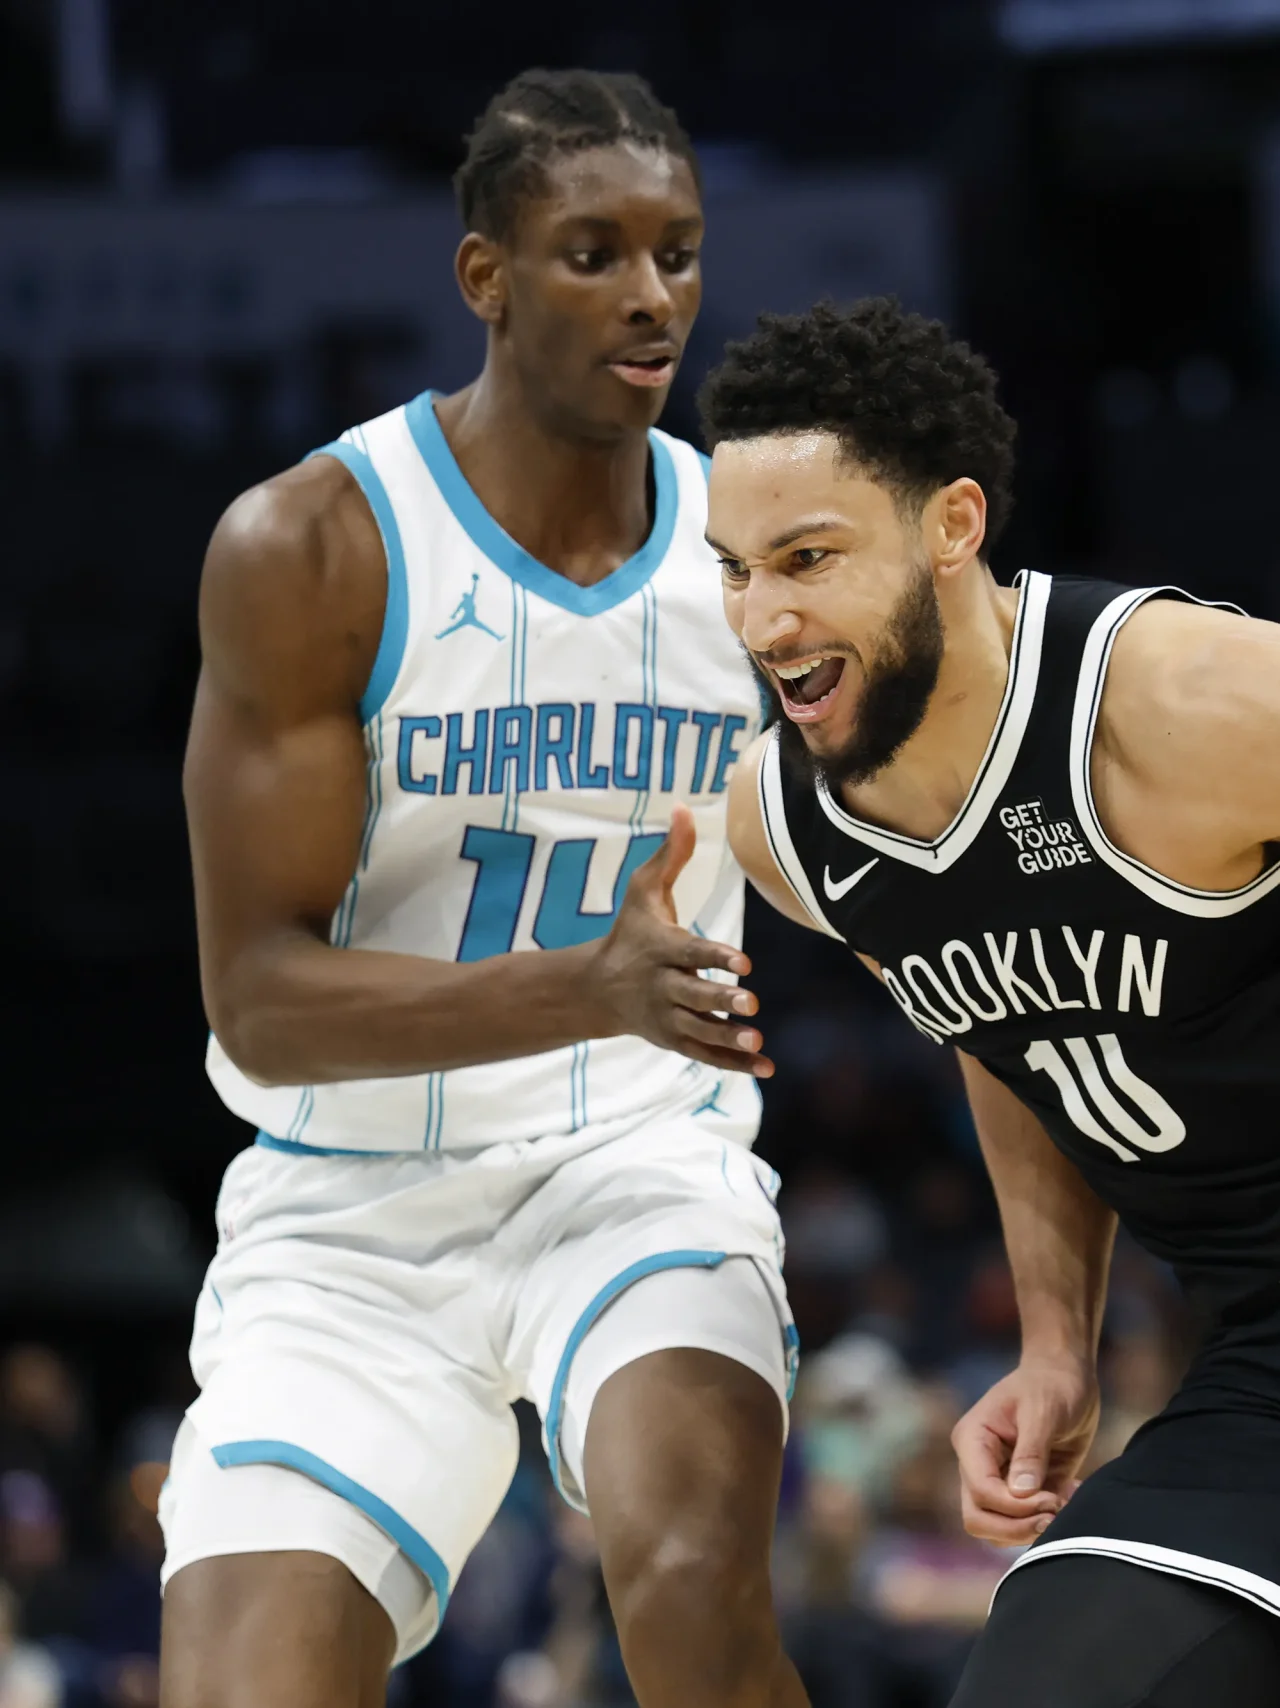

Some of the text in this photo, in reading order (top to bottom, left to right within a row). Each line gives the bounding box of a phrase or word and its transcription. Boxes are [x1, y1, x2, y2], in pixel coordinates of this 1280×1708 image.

[397, 702, 747, 796] CHARLOTTE
[999, 801, 1042, 829] GET
[1006, 822, 1077, 852] YOUR
[1017, 843, 1092, 875] GUIDE
[456, 824, 668, 963] 14
[880, 925, 1168, 1045] ROOKLYN
[1024, 1033, 1186, 1162] 10
